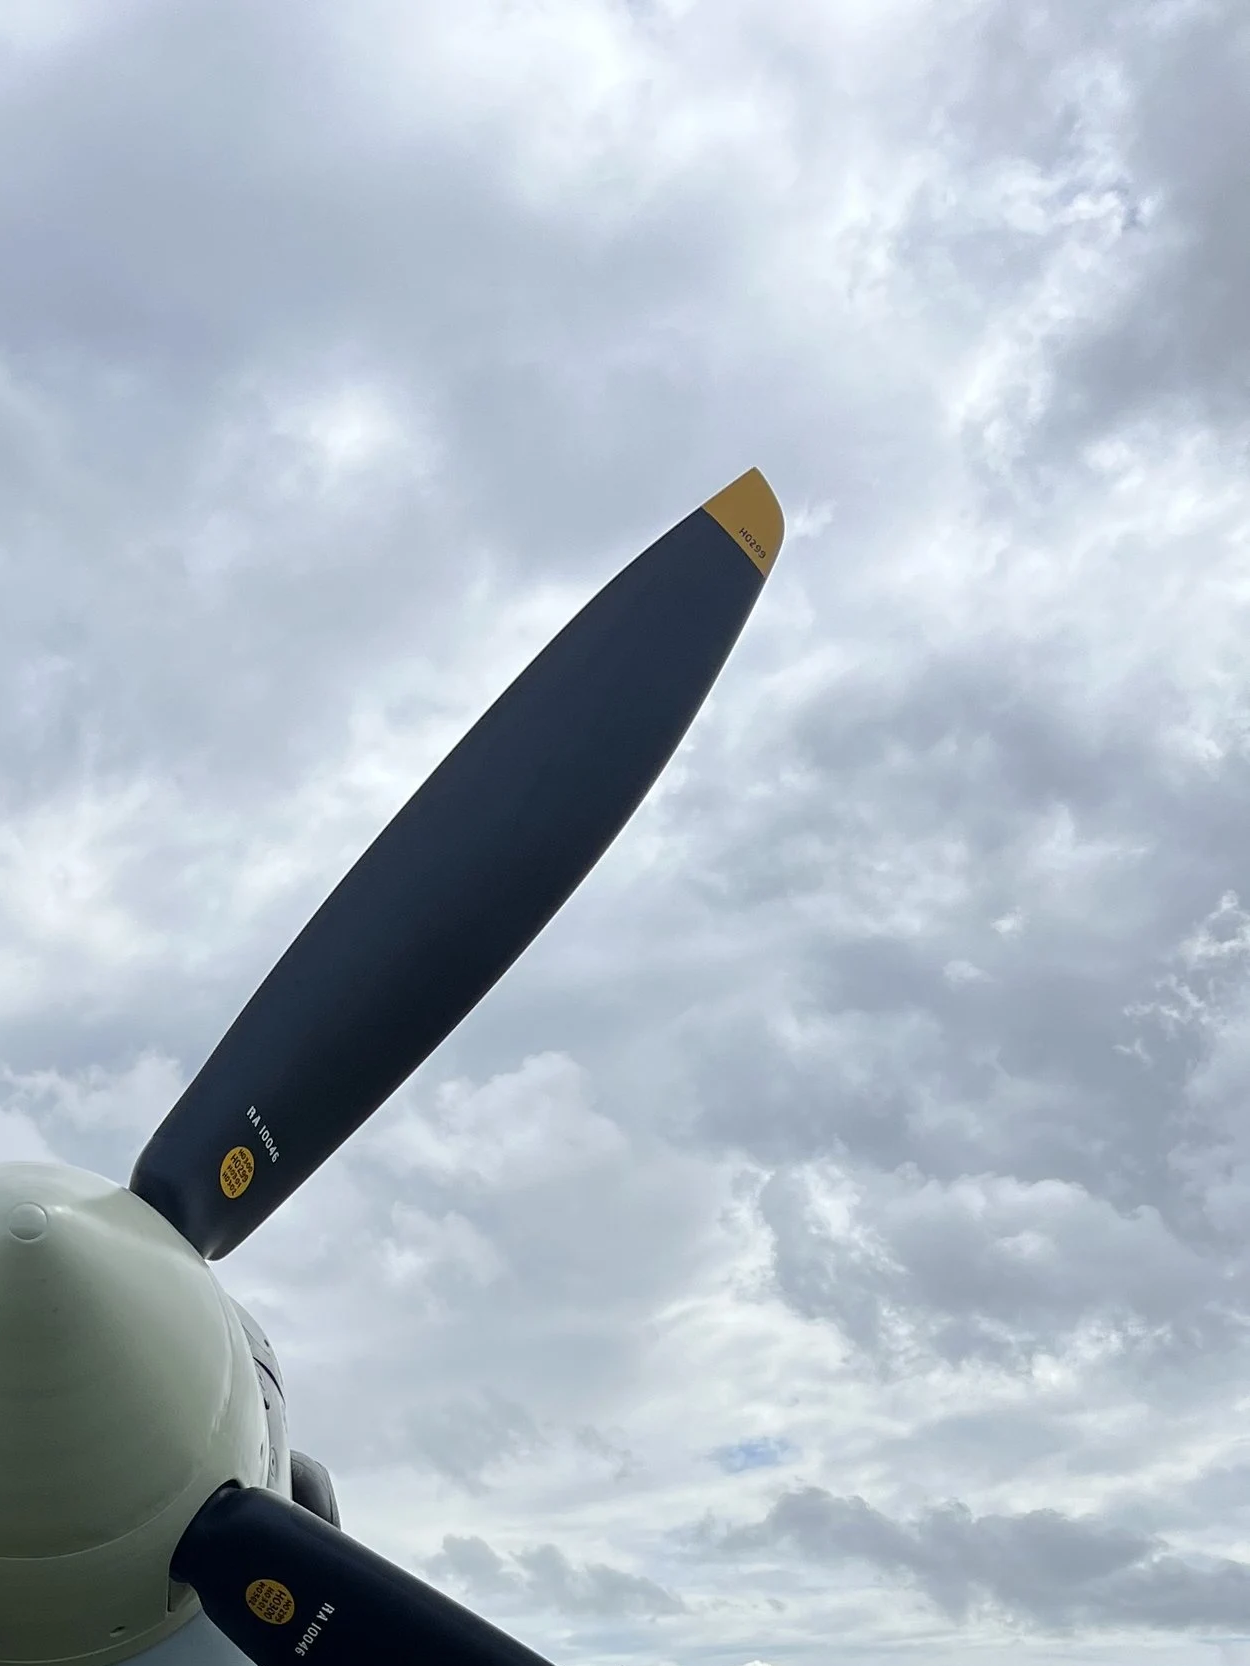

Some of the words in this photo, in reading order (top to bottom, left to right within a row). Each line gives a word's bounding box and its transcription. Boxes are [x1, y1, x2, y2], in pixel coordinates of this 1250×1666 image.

[246, 1105, 261, 1127] RA
[259, 1125, 280, 1163] 10046
[316, 1602, 335, 1622] RA
[295, 1622, 322, 1656] 10046
